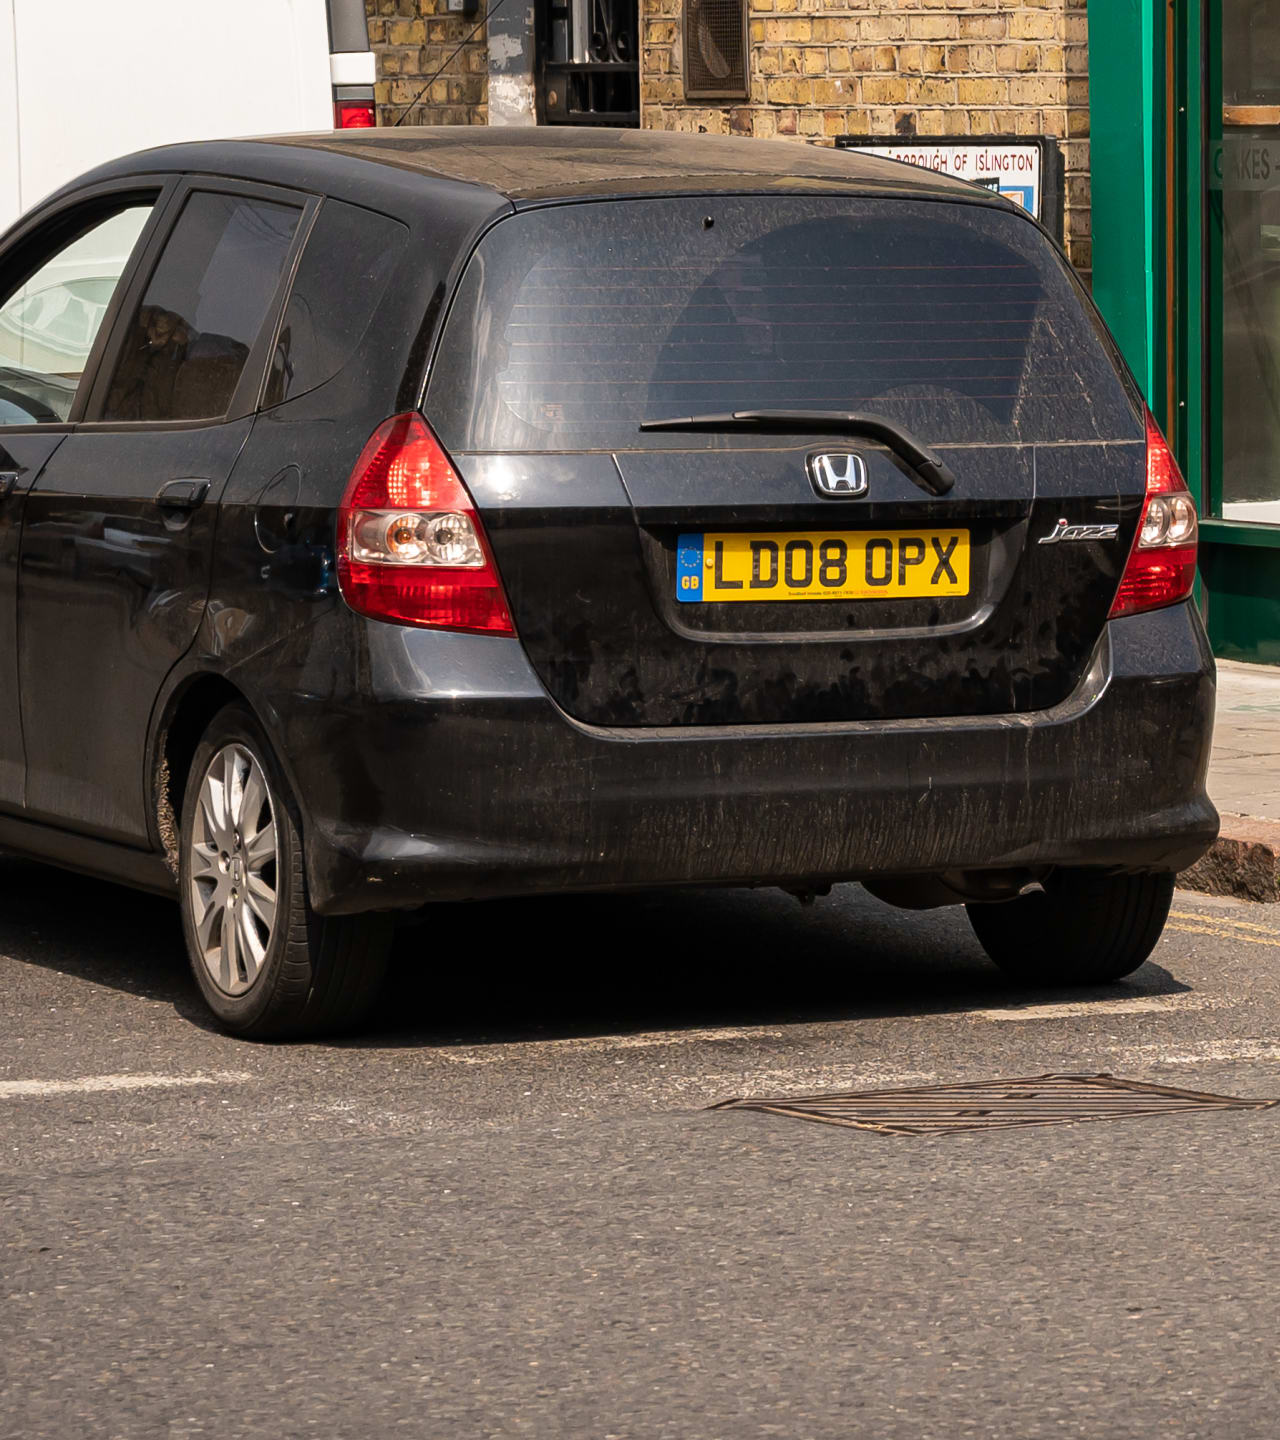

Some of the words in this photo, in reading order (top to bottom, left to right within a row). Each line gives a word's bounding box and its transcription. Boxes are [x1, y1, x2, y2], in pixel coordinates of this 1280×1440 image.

[954, 155, 968, 171] OF
[975, 154, 1033, 171] ISLINGTON
[714, 539, 848, 590] LD08
[864, 536, 960, 587] OPX
[681, 575, 700, 590] GB
